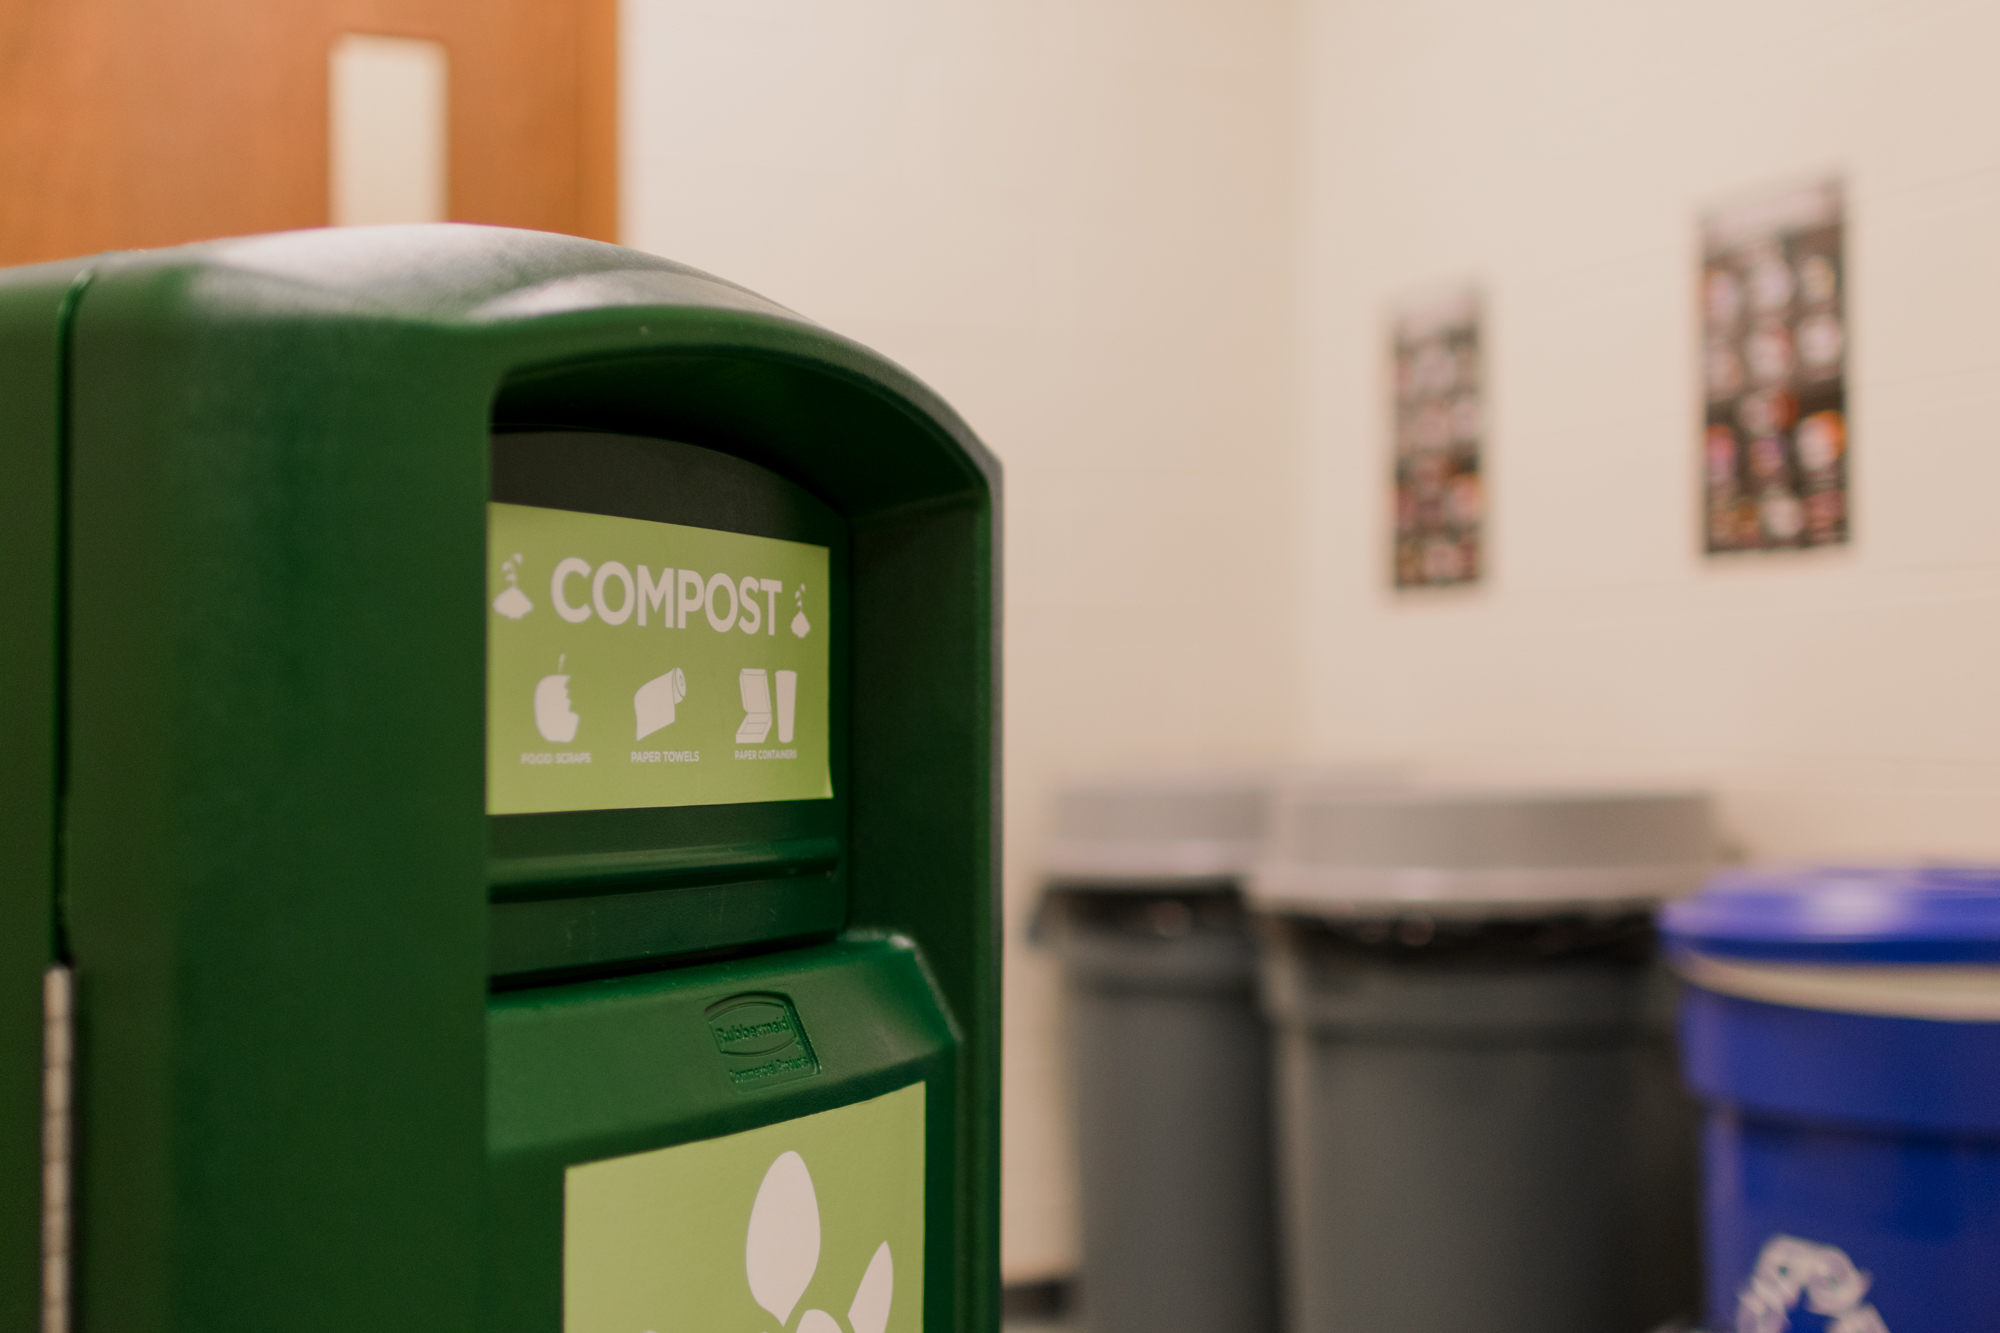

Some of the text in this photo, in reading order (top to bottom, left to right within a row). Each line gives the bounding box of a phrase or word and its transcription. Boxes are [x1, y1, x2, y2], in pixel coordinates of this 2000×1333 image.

[550, 556, 783, 636] COMPOST
[520, 752, 592, 765] FOOD SCRAPS
[630, 750, 700, 763] PAPER TOWELS
[734, 749, 797, 760] PAPER CONTAINERS
[715, 1015, 790, 1043] Rubbermaid
